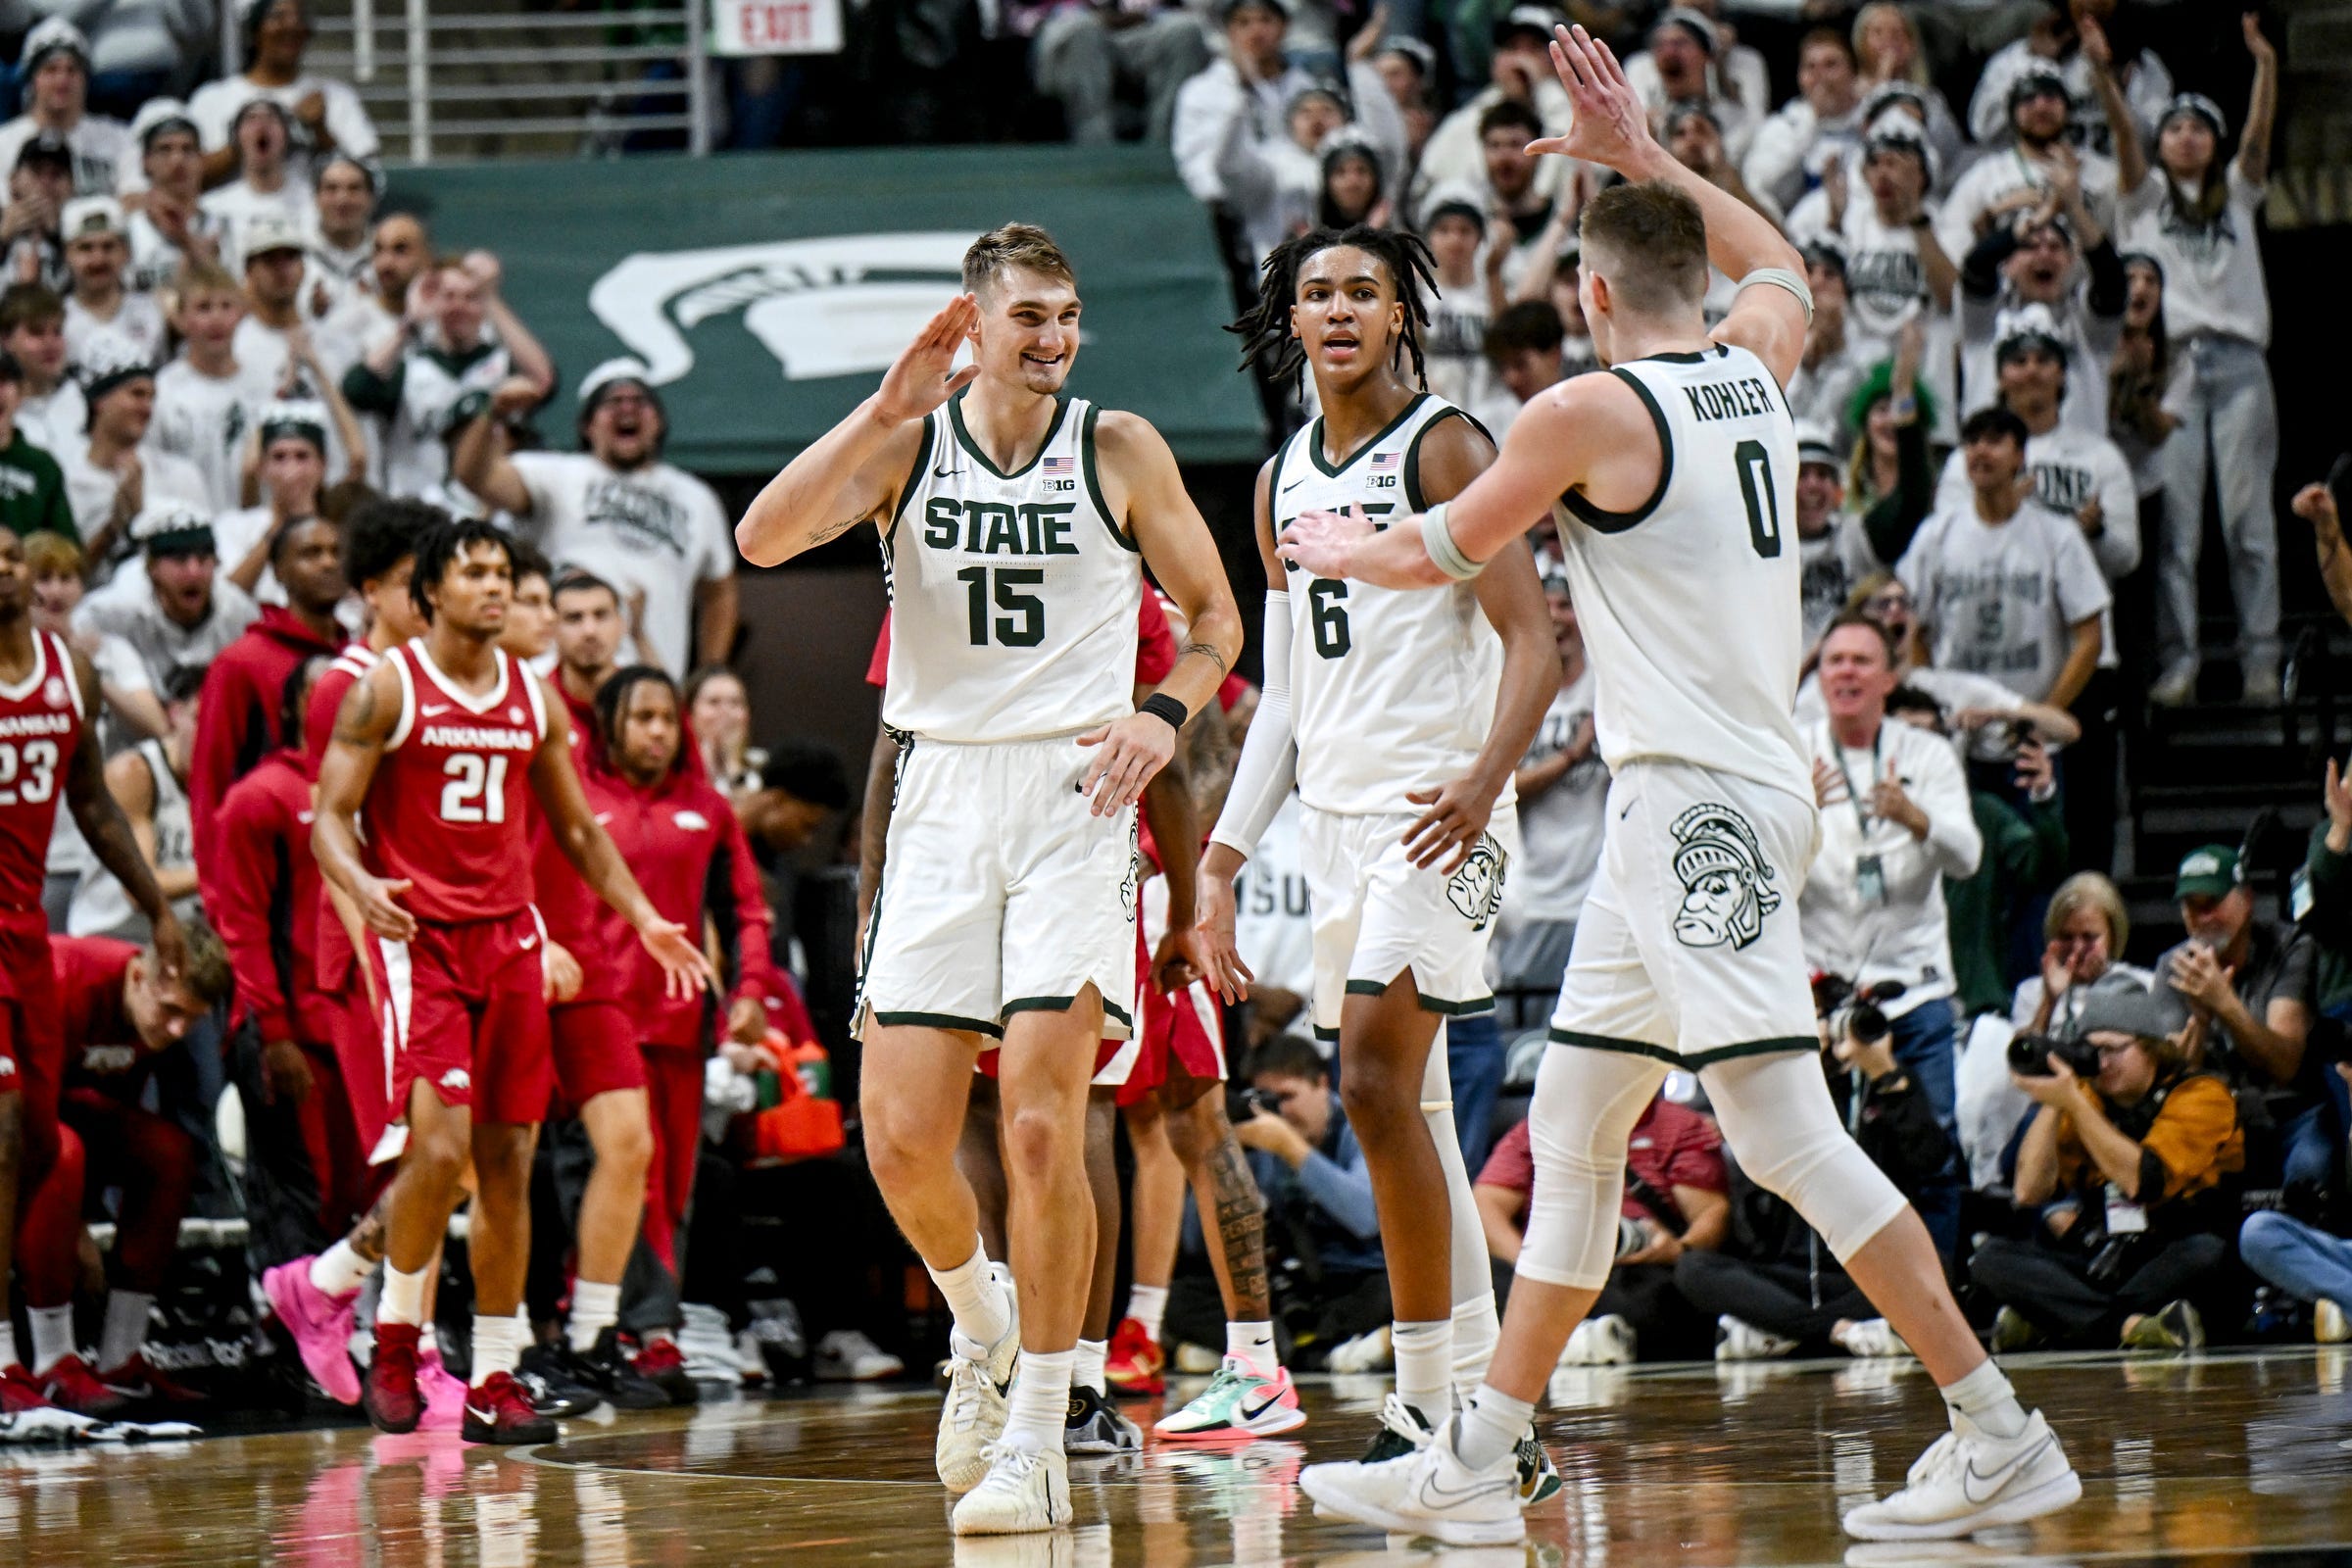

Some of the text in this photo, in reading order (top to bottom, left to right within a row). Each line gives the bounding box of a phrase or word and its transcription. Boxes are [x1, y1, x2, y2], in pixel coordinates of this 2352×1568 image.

[741, 3, 811, 44] EXIT
[1681, 377, 1776, 422] KOHLER
[924, 496, 1080, 555] STATE
[1735, 439, 1782, 559] 0
[956, 565, 1046, 648] 15
[1308, 577, 1351, 660] 6
[420, 724, 534, 752] ARKANSAS
[440, 752, 509, 824] 21
